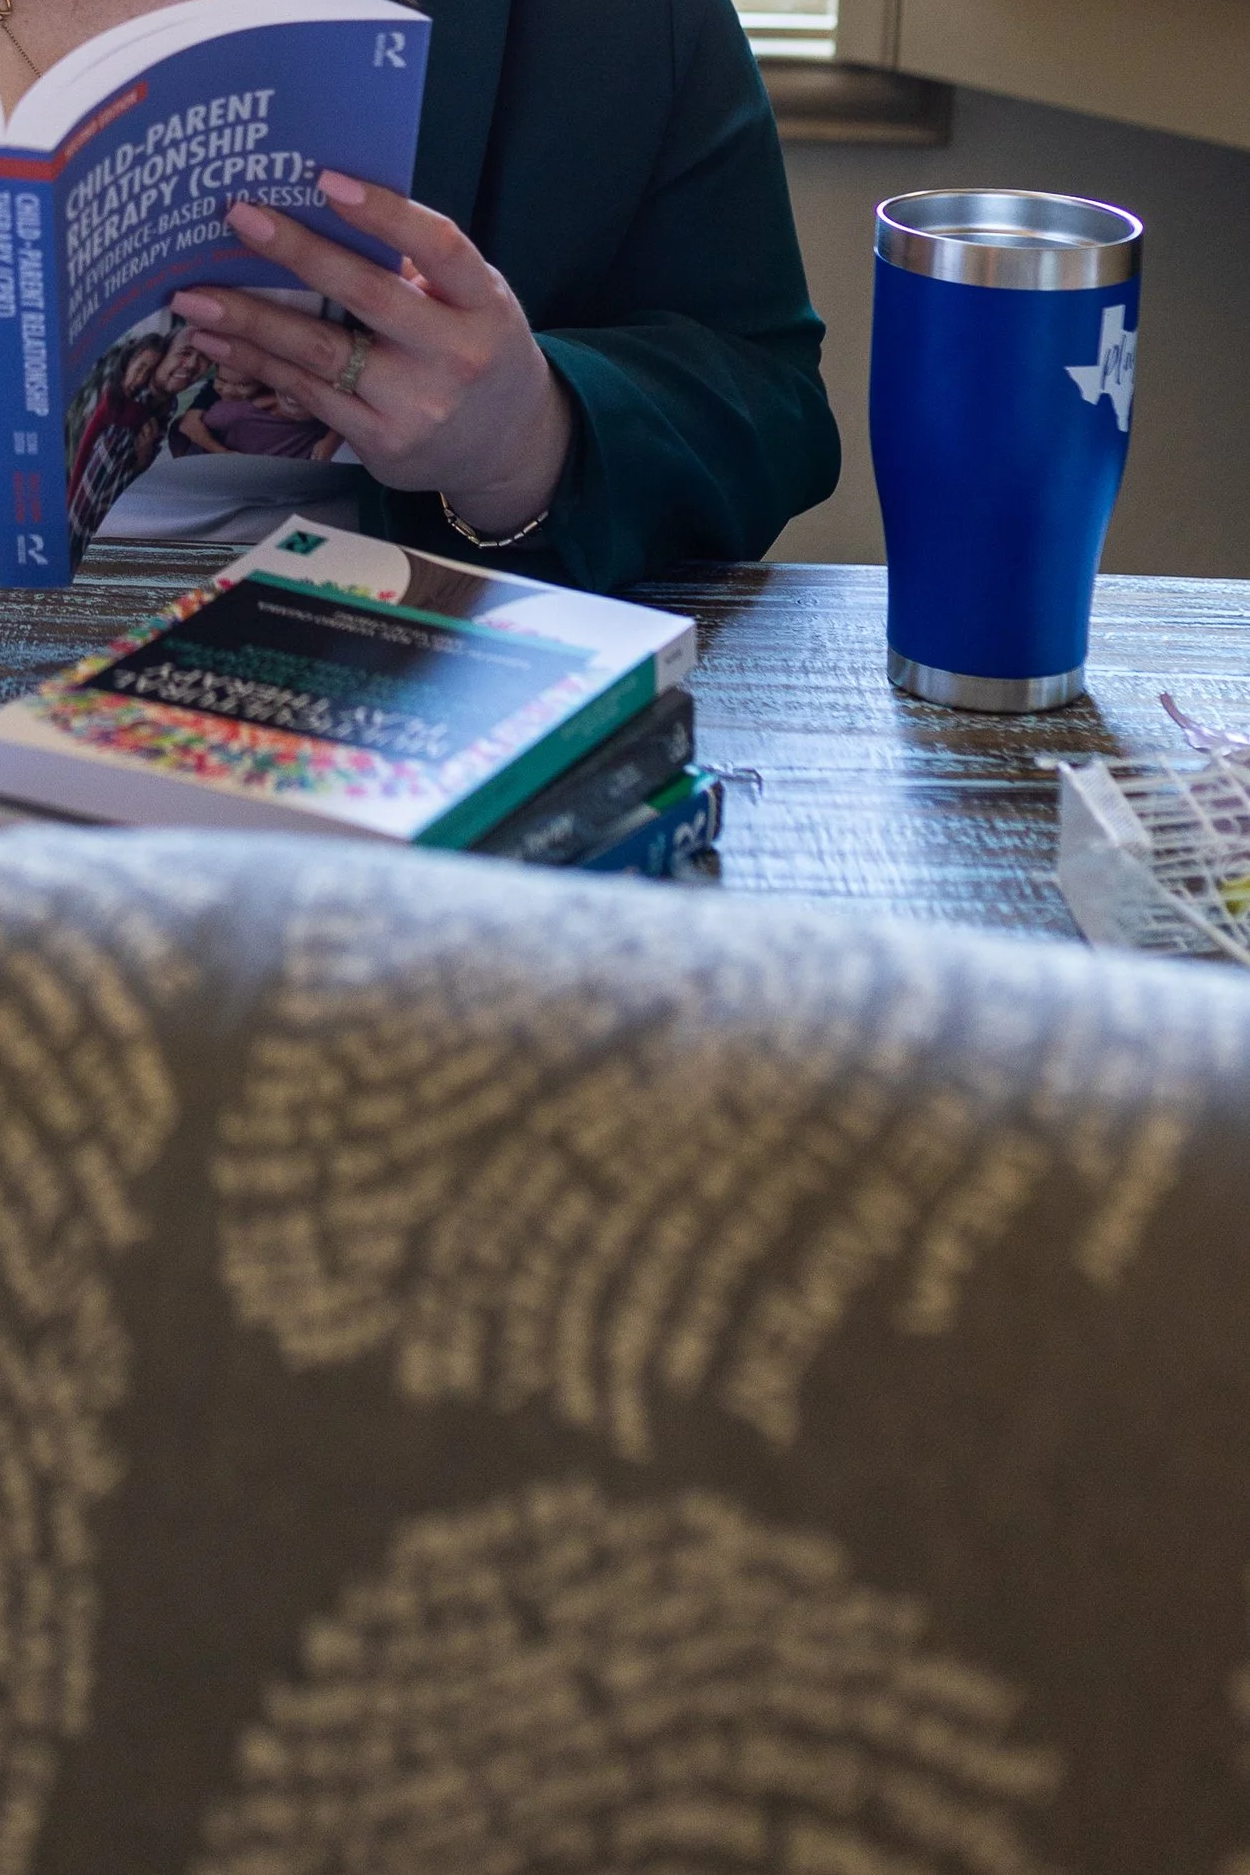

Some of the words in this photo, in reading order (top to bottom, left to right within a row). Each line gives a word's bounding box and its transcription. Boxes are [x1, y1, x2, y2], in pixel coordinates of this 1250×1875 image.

[373, 32, 407, 68] R
[66, 88, 275, 221] CHILD-PARENT
[66, 121, 270, 257] RELATIONSHIP
[68, 174, 180, 287] THERAPY
[188, 151, 316, 199] (CPRT):
[85, 195, 217, 294] EVIDENCE-BASED
[225, 185, 329, 209] 10-SESSIO
[104, 237, 172, 299] THERAPY
[175, 220, 234, 252] MODE
[16, 534, 49, 565] R
